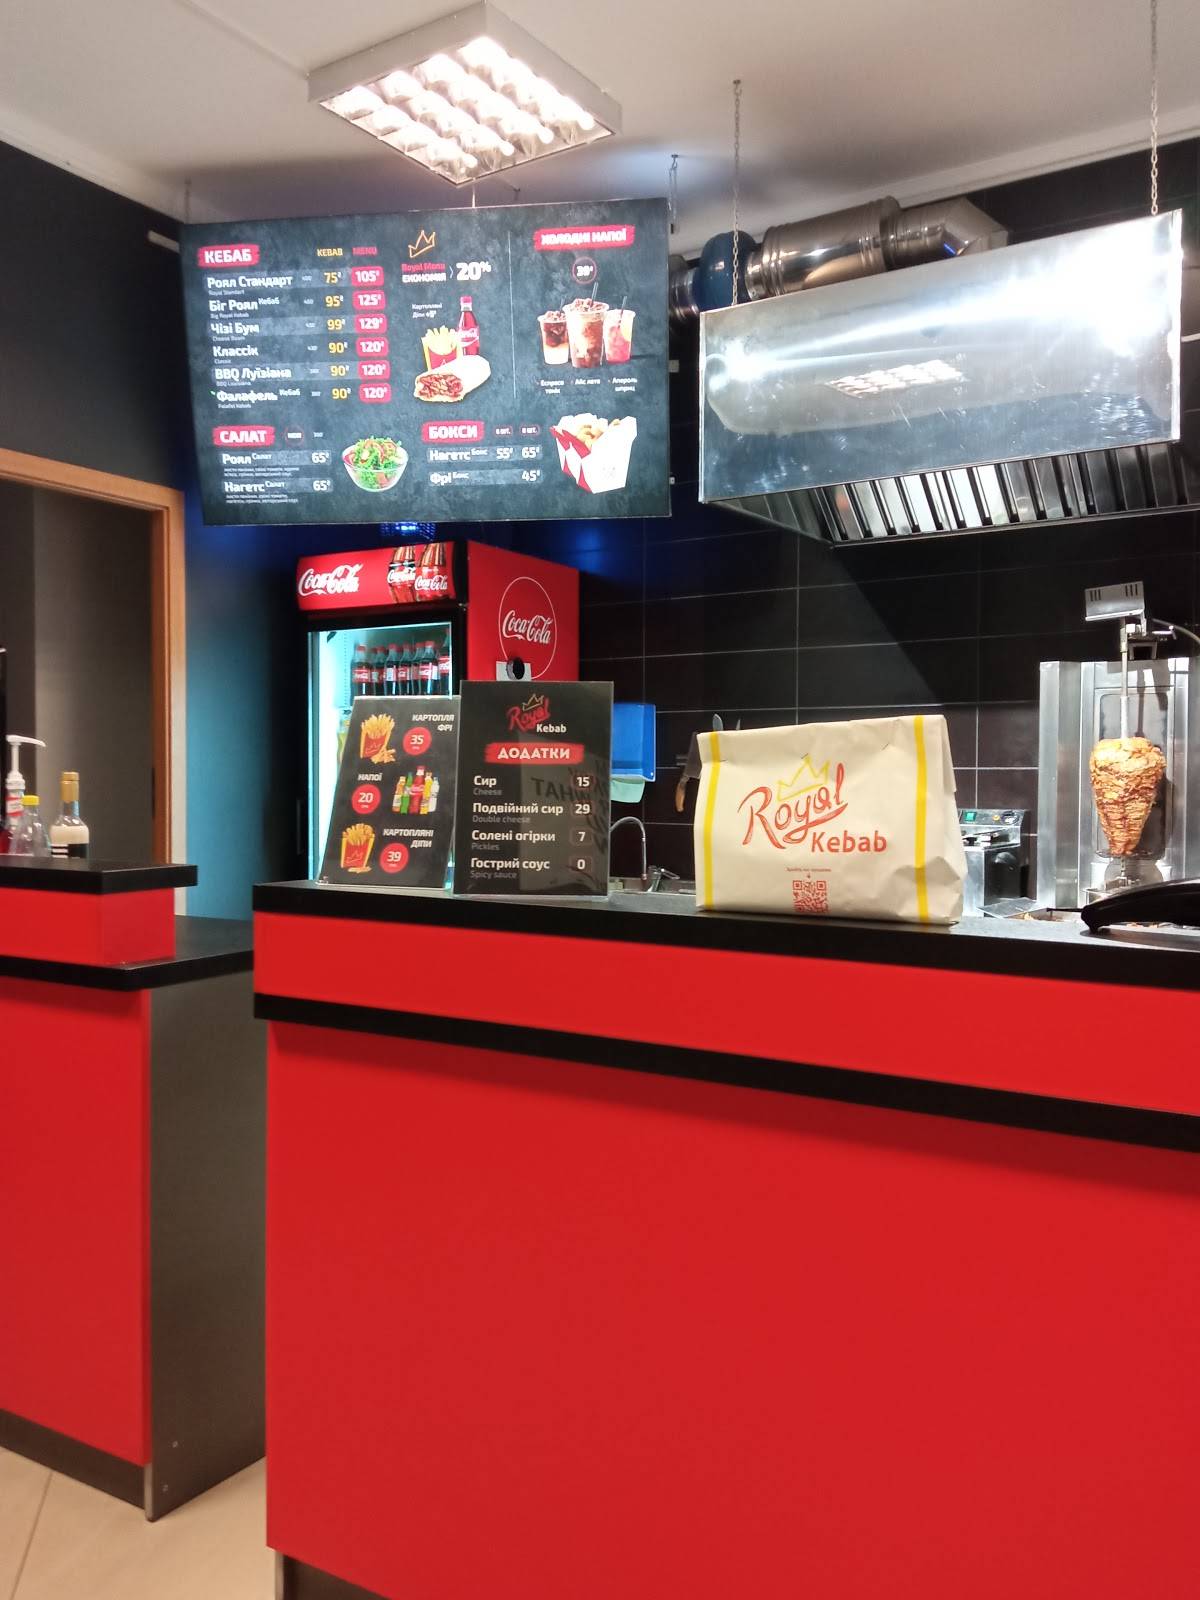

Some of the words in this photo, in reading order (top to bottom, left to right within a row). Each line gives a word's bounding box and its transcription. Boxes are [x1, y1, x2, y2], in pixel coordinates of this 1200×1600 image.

[592, 228, 626, 242] НАПОЇ
[204, 248, 252, 264] КЕБАБ
[455, 261, 491, 280] 20%
[207, 277, 237, 288] Роял
[238, 275, 293, 289] Стандарт
[209, 300, 226, 311] Біг
[228, 299, 258, 311] Роял
[210, 323, 233, 334] Чізі
[234, 322, 260, 335] Бум
[213, 345, 259, 357] Классік
[215, 368, 240, 381] BBQ
[241, 367, 292, 382] Луїзіана
[216, 390, 278, 403] Фалафель
[219, 430, 267, 443] САЛАТ
[428, 425, 477, 439] БОКСИ
[222, 453, 252, 464] Роял
[429, 449, 471, 461] Нагетс
[430, 472, 451, 486] Фрі
[224, 481, 265, 492] Нагетс
[298, 564, 364, 596] Coca-Cola
[502, 609, 552, 645] Coca-Cola
[412, 714, 454, 722] КАРТОПЛЯ
[507, 697, 550, 733] Royal
[437, 723, 453, 732] ФРІ
[536, 723, 567, 733] Kebab
[410, 734, 424, 745] 35
[497, 747, 570, 760] ДОДАТКИ
[357, 772, 383, 782] НАПОЇ
[473, 775, 497, 788] Сир
[576, 776, 590, 787] 15
[358, 792, 374, 803] 20
[473, 788, 502, 796] Cheese
[472, 802, 538, 814] Подвійний
[541, 804, 564, 816] сир
[575, 803, 591, 815] 29
[737, 762, 849, 849] Royal
[472, 815, 500, 823] Double
[502, 815, 531, 823] cheese
[383, 828, 434, 837] КАРТОПЛЯНІ
[472, 829, 513, 841] Солені
[515, 831, 556, 844] огірки
[578, 832, 586, 842] 7
[410, 839, 432, 848] ДІПИ
[472, 842, 499, 850] Pickles
[811, 830, 887, 853] Kebab
[387, 851, 402, 862] 39
[470, 857, 520, 870] Гострий
[522, 860, 550, 870] соус
[577, 859, 586, 870] 0
[470, 870, 492, 879] Spicy
[494, 871, 517, 879] sauce
